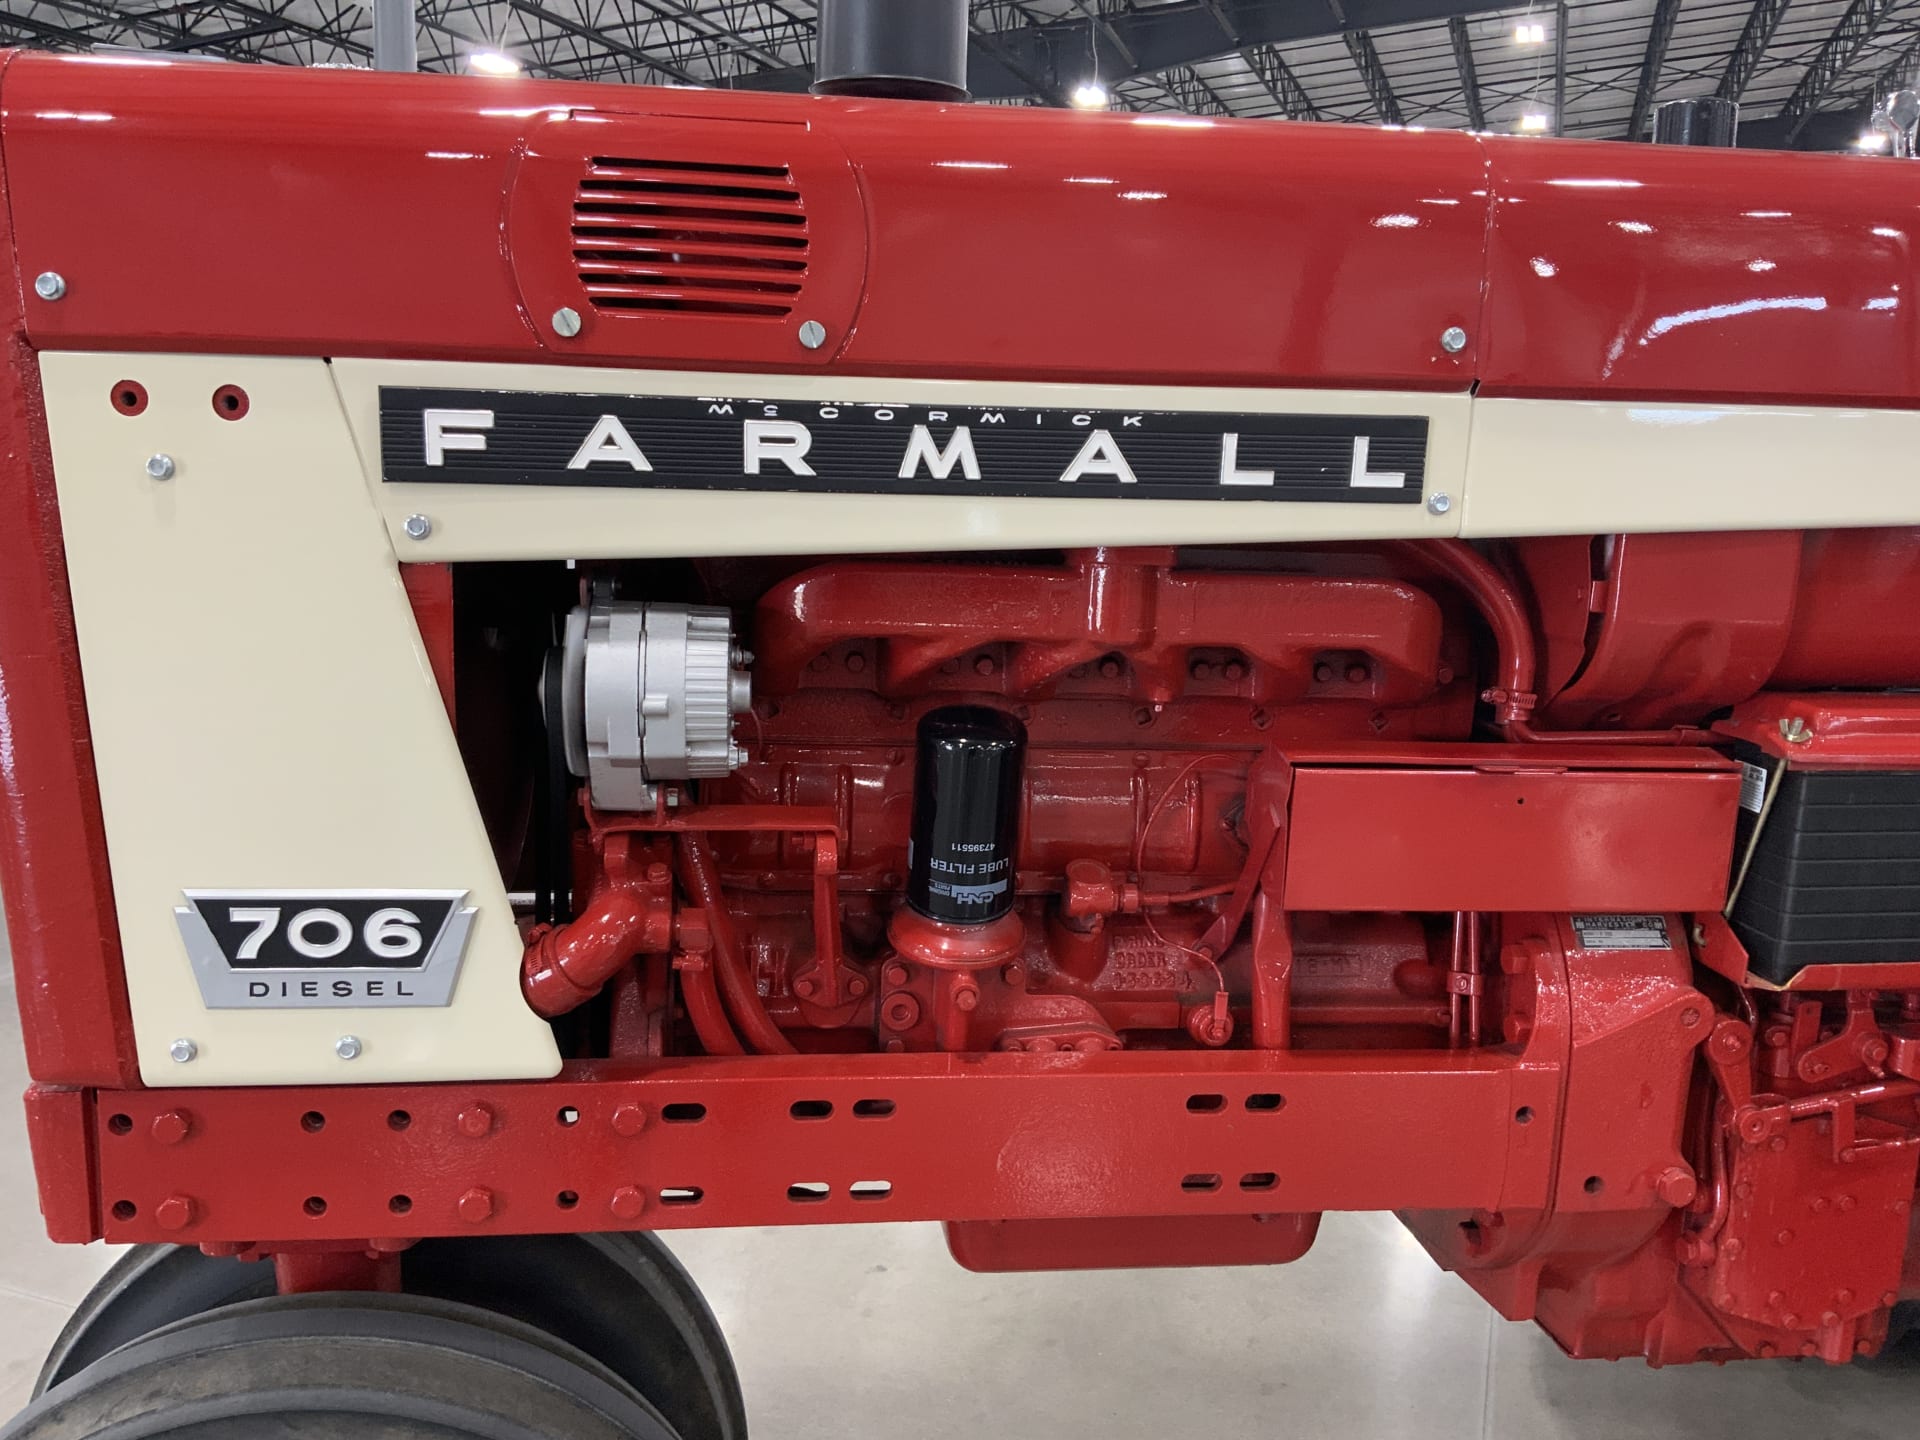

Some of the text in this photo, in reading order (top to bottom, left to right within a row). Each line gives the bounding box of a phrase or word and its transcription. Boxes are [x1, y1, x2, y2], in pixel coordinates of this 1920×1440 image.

[423, 408, 1406, 489] FARMALL
[951, 843, 995, 852] 47395511
[930, 857, 1009, 874] LUBE FILTER
[957, 891, 994, 904] CNH
[229, 907, 423, 960] 706
[249, 980, 414, 998] DIESEL
